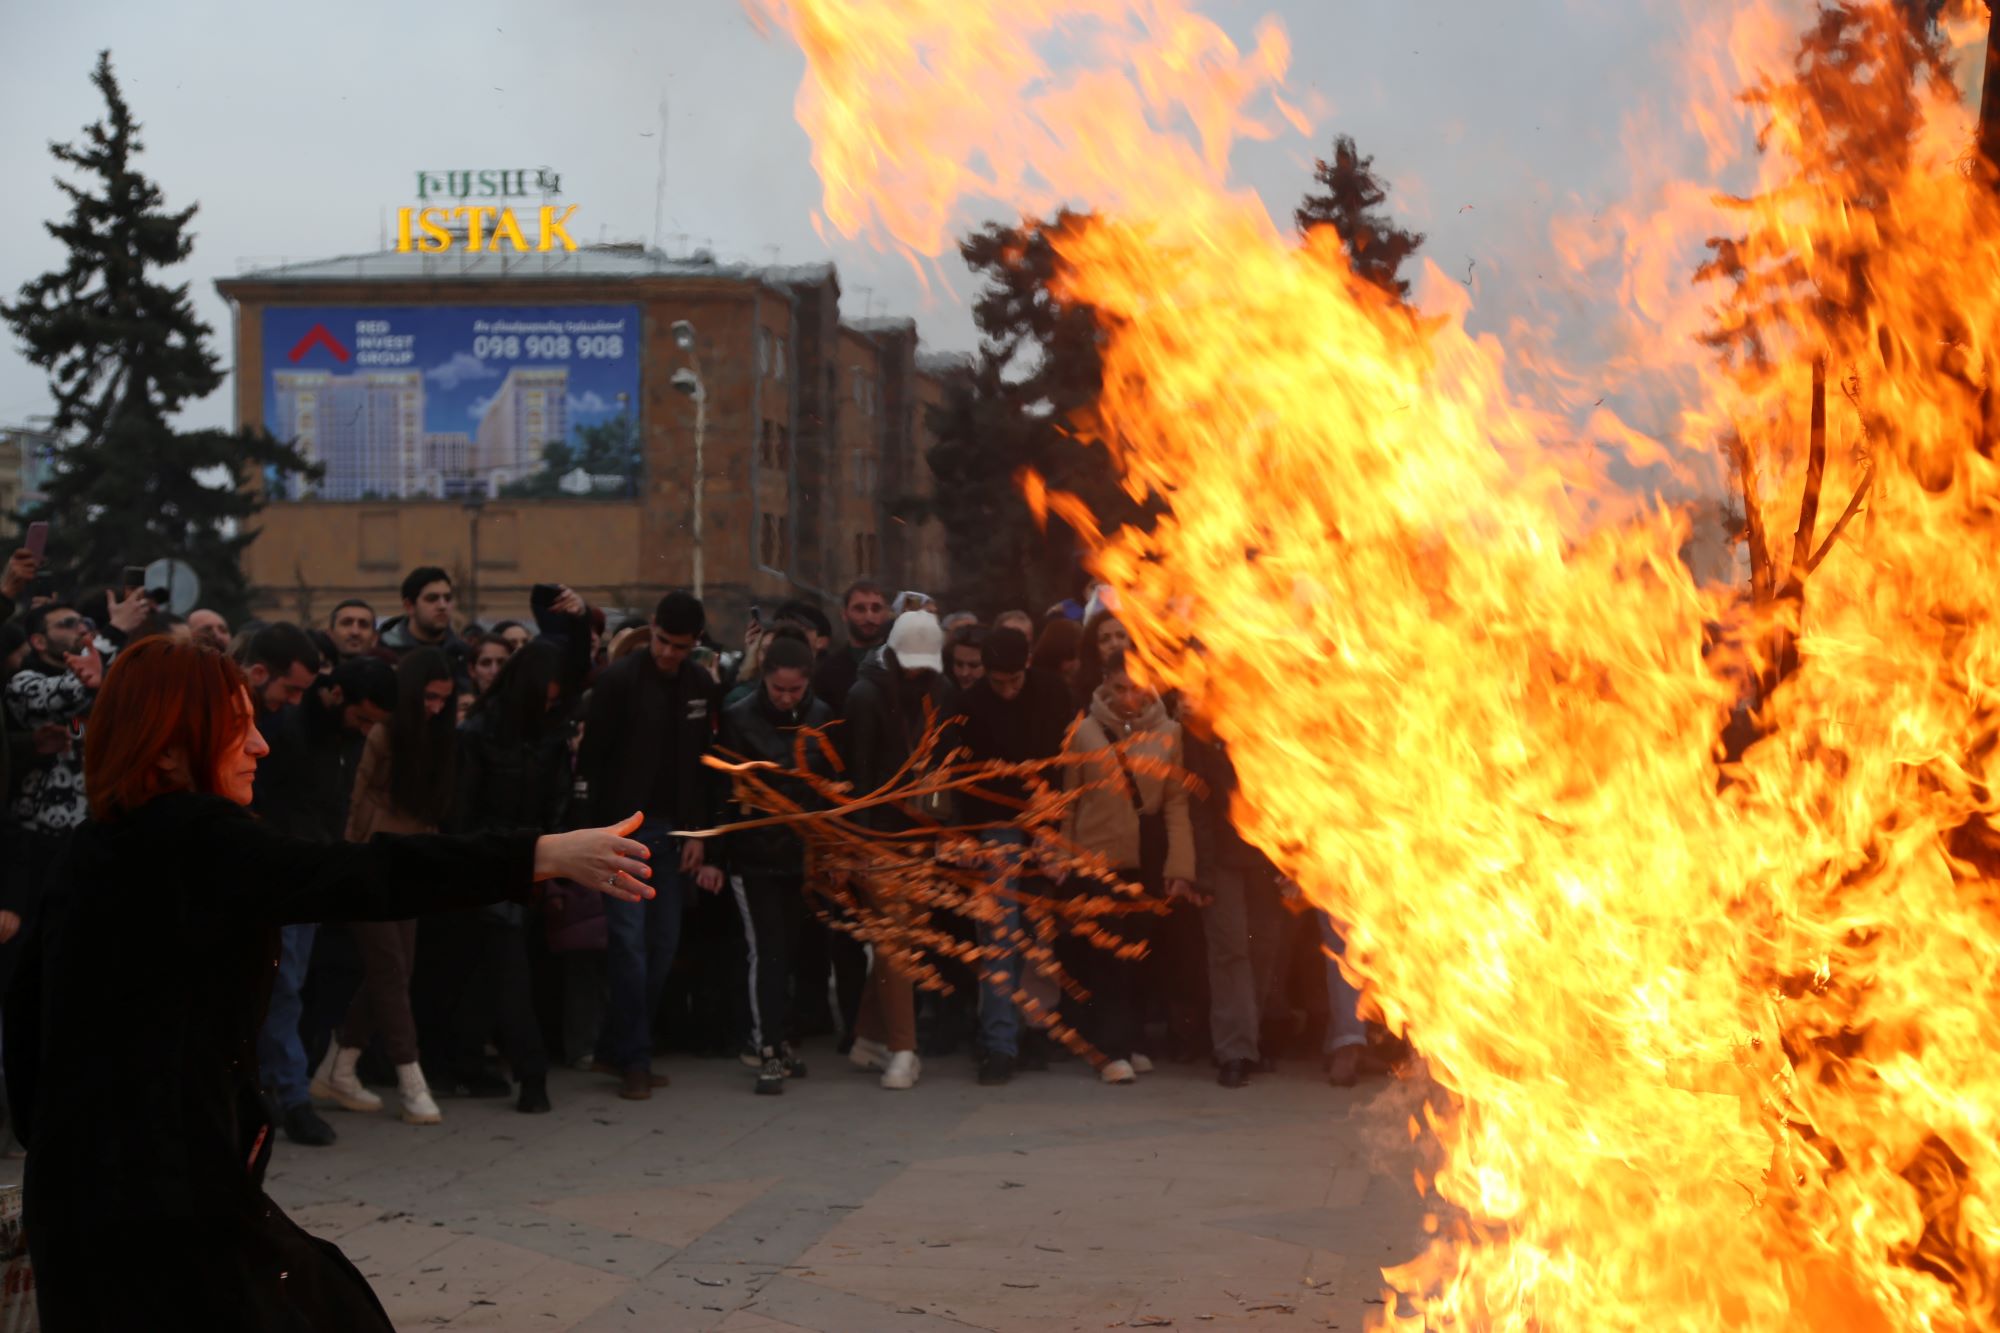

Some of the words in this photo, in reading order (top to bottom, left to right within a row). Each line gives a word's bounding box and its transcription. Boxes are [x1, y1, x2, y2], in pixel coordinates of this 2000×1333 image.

[396, 203, 579, 253] ISTAK
[356, 335, 415, 349] INVEST
[473, 335, 520, 359] 098
[525, 335, 571, 359] 908
[576, 335, 623, 359] 908
[356, 351, 414, 365] GROUP
